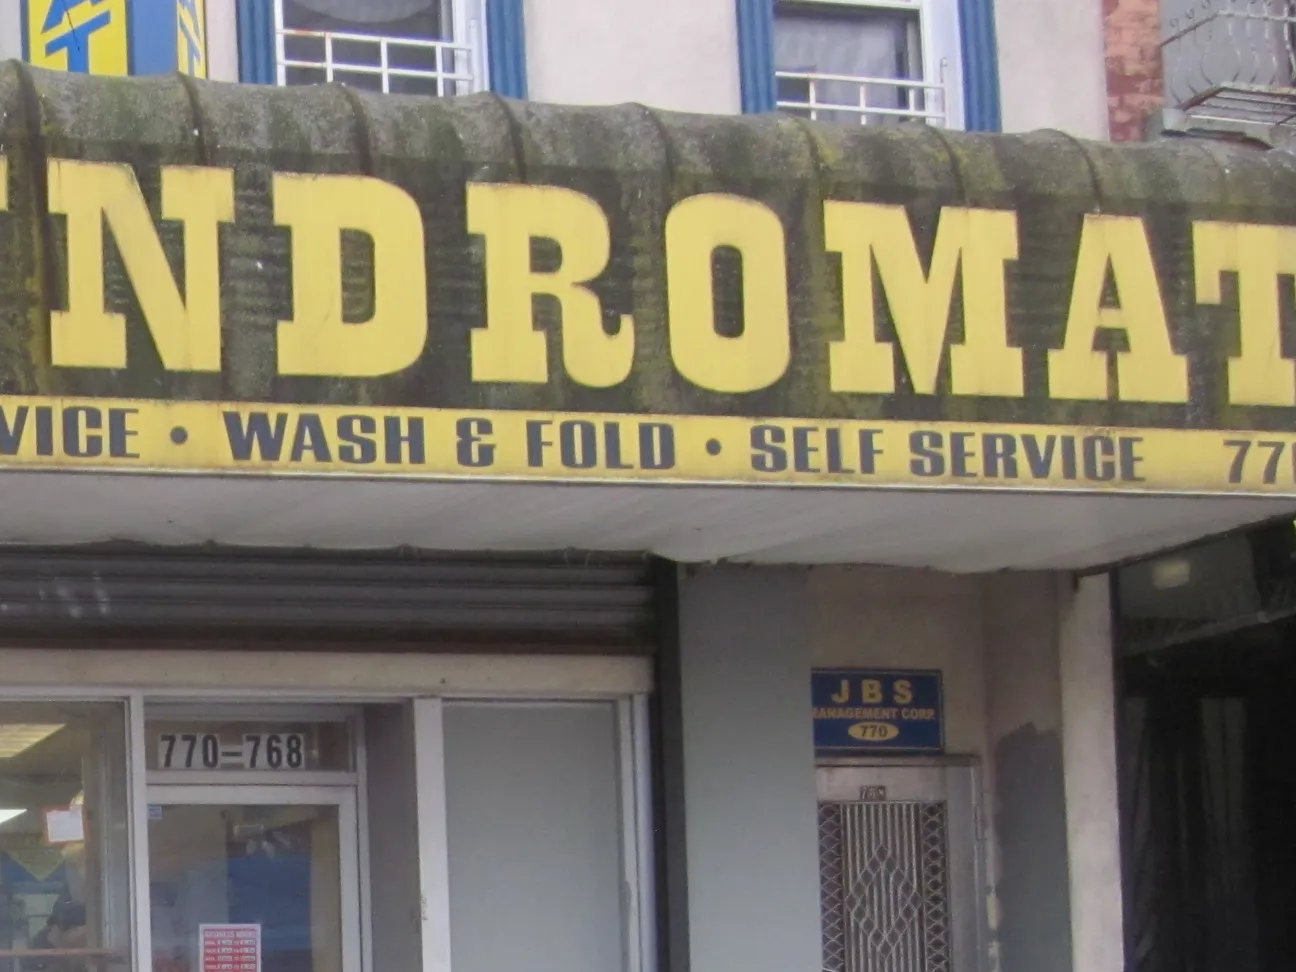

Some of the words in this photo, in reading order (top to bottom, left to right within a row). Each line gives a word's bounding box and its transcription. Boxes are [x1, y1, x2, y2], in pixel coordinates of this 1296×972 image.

[222, 411, 426, 465] WASH
[456, 417, 497, 468] &
[526, 419, 676, 470] FOLD
[750, 424, 884, 474] SELF
[909, 430, 1145, 482] SERVICE
[859, 724, 889, 738] 770
[160, 734, 303, 769] 770-768
